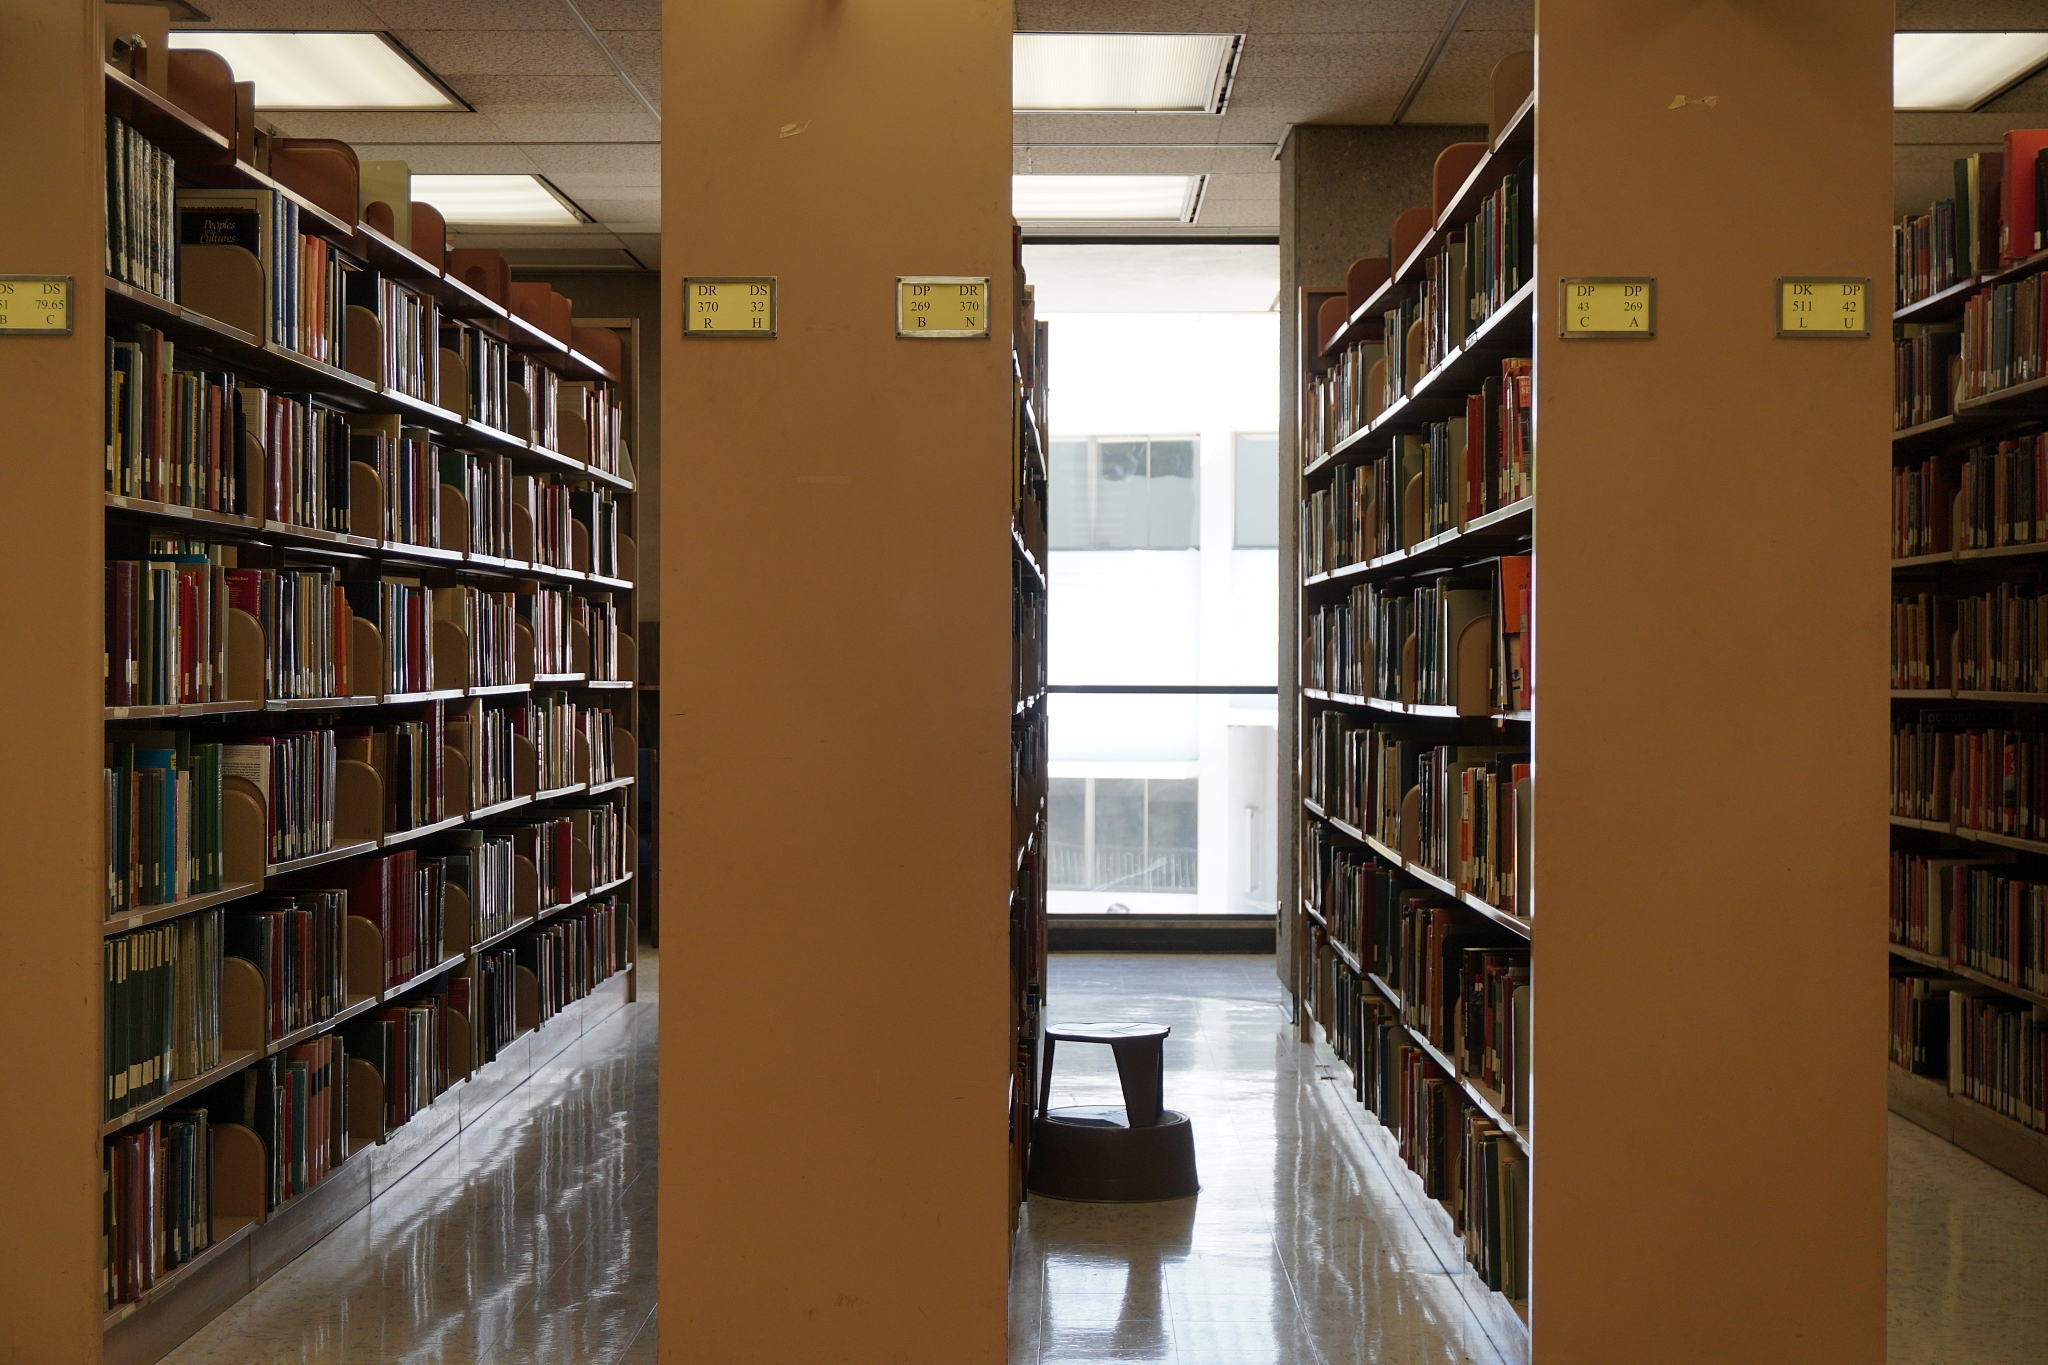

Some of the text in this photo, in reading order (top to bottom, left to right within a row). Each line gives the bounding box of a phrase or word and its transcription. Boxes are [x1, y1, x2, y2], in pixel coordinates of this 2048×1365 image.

[203, 219, 236, 233] Peoples
[200, 233, 236, 244] Cultures
[43, 283, 61, 295] DS
[698, 285, 718, 296] DR
[750, 285, 768, 296] DS
[913, 285, 931, 296] DP
[959, 285, 978, 296] DR
[1577, 285, 1595, 297] DP
[1624, 285, 1642, 297] DP
[1793, 284, 1813, 295] DK
[1842, 284, 1861, 296] DP
[35, 299, 64, 310] 79.65
[697, 301, 719, 313] 370
[750, 301, 765, 312] 32
[910, 301, 931, 312] 269
[960, 301, 979, 312] 370
[1577, 301, 1590, 312] 43
[1623, 301, 1643, 312] 269
[1792, 300, 1812, 312] 511
[1842, 301, 1857, 313] 42
[46, 314, 55, 325] C
[704, 318, 713, 329] R
[752, 317, 762, 329] H
[917, 316, 927, 327] B
[965, 316, 976, 327] N
[1580, 316, 1590, 328] C
[1629, 316, 1639, 328] A
[1799, 317, 1808, 328] L
[1844, 317, 1854, 329] U
